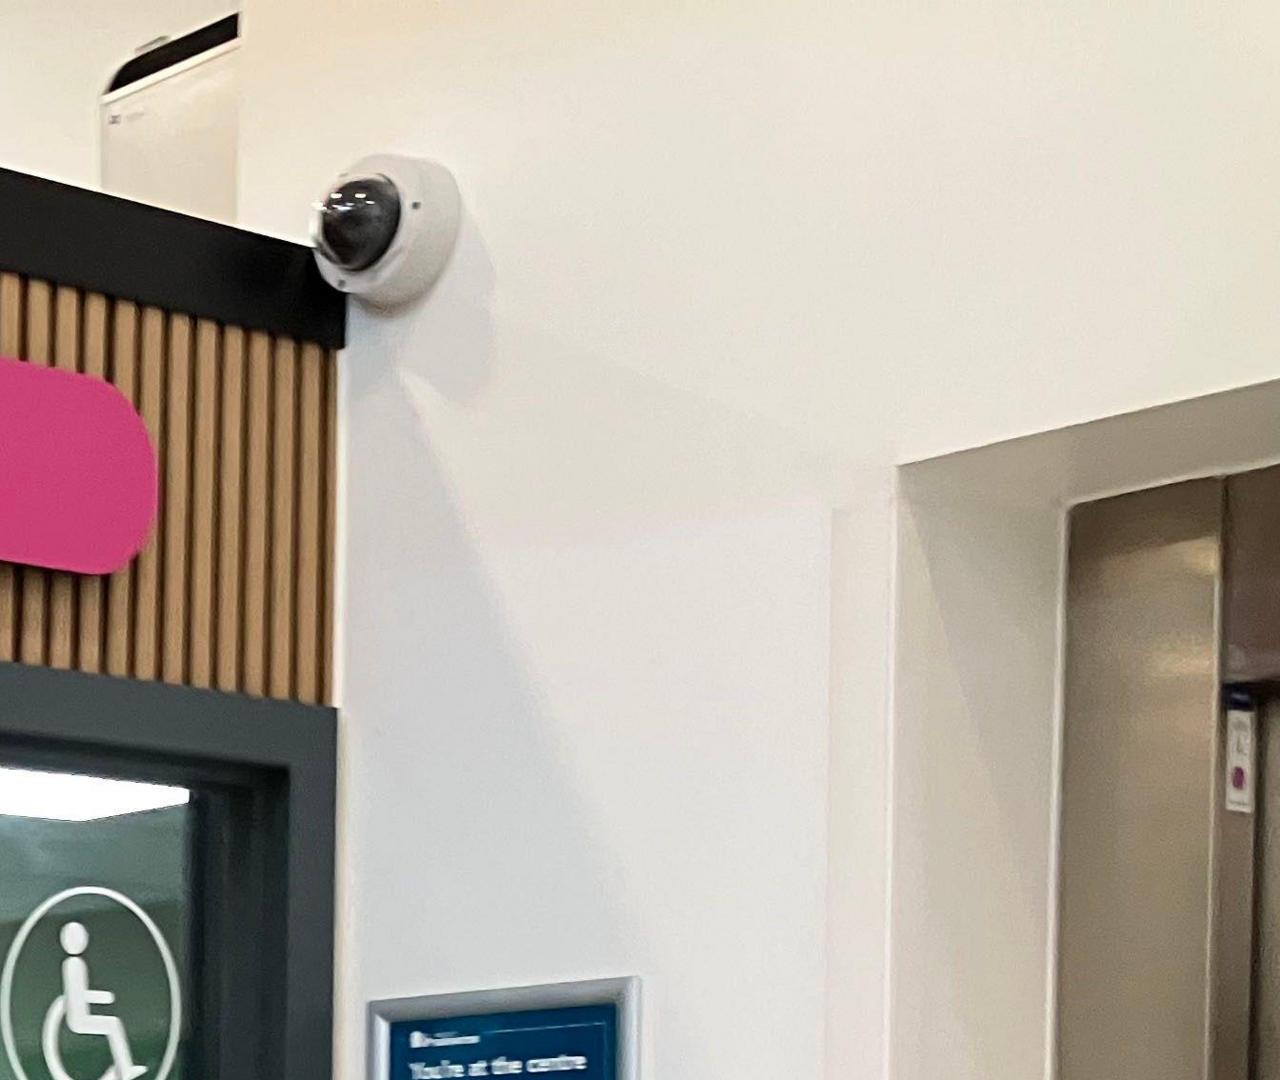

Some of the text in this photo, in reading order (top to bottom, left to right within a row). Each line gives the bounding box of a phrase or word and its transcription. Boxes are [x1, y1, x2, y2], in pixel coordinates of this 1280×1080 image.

[467, 1060, 489, 1076] at
[492, 1056, 523, 1075] the
[526, 1054, 587, 1073] centre
